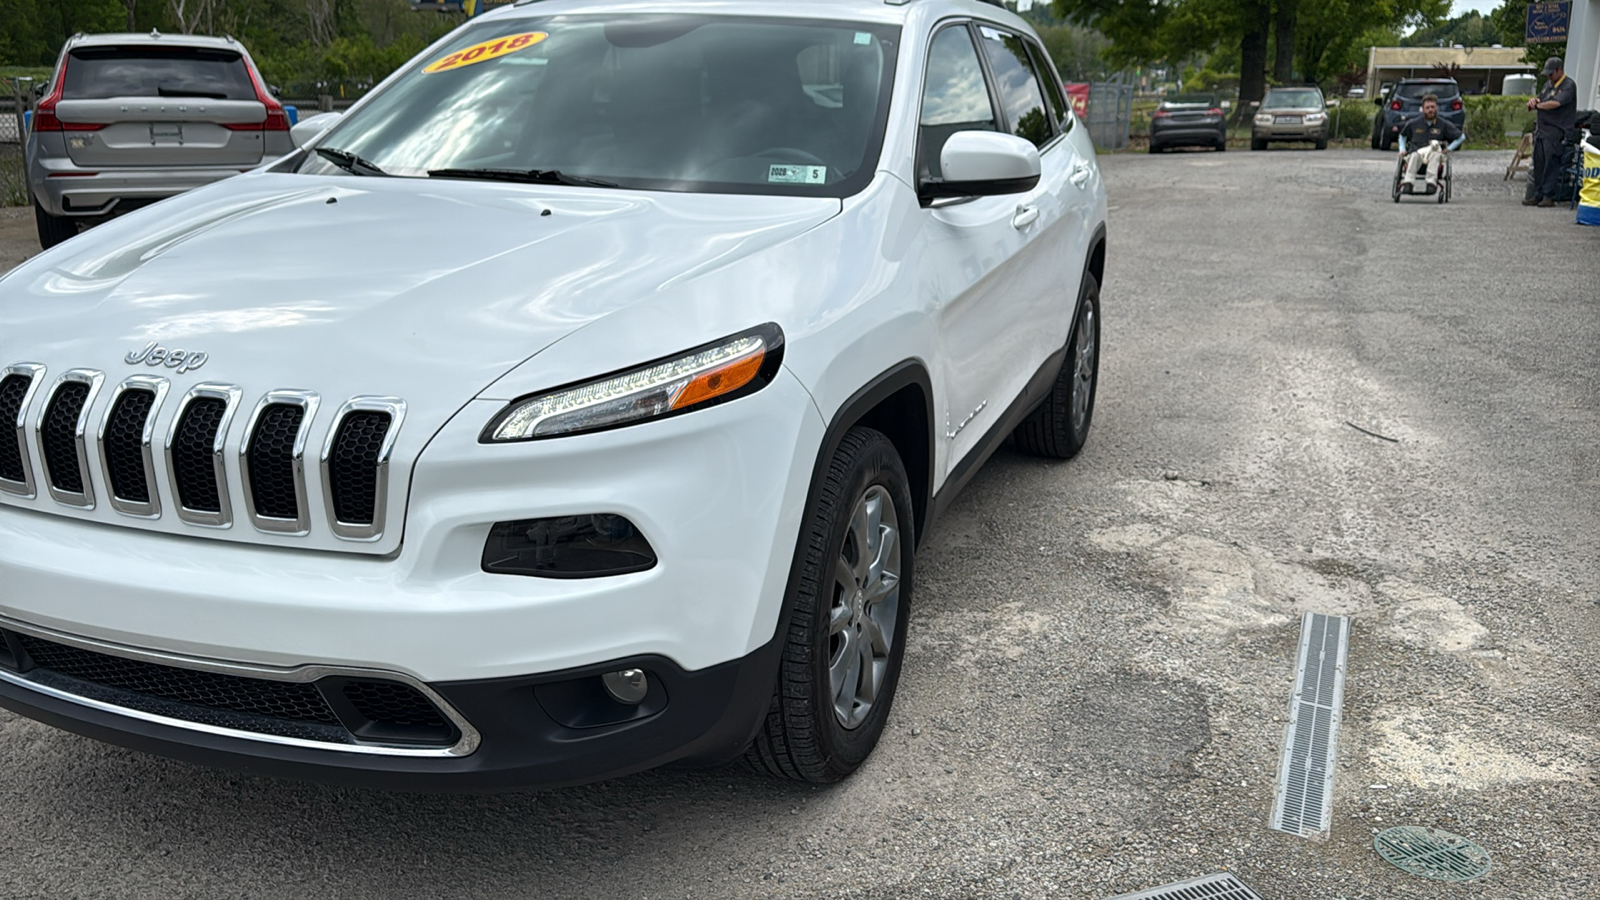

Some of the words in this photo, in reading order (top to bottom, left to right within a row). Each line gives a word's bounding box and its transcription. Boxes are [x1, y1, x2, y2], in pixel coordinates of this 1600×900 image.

[434, 33, 534, 71] 2018
[812, 169, 819, 179] 5
[124, 341, 209, 375] Jeep
